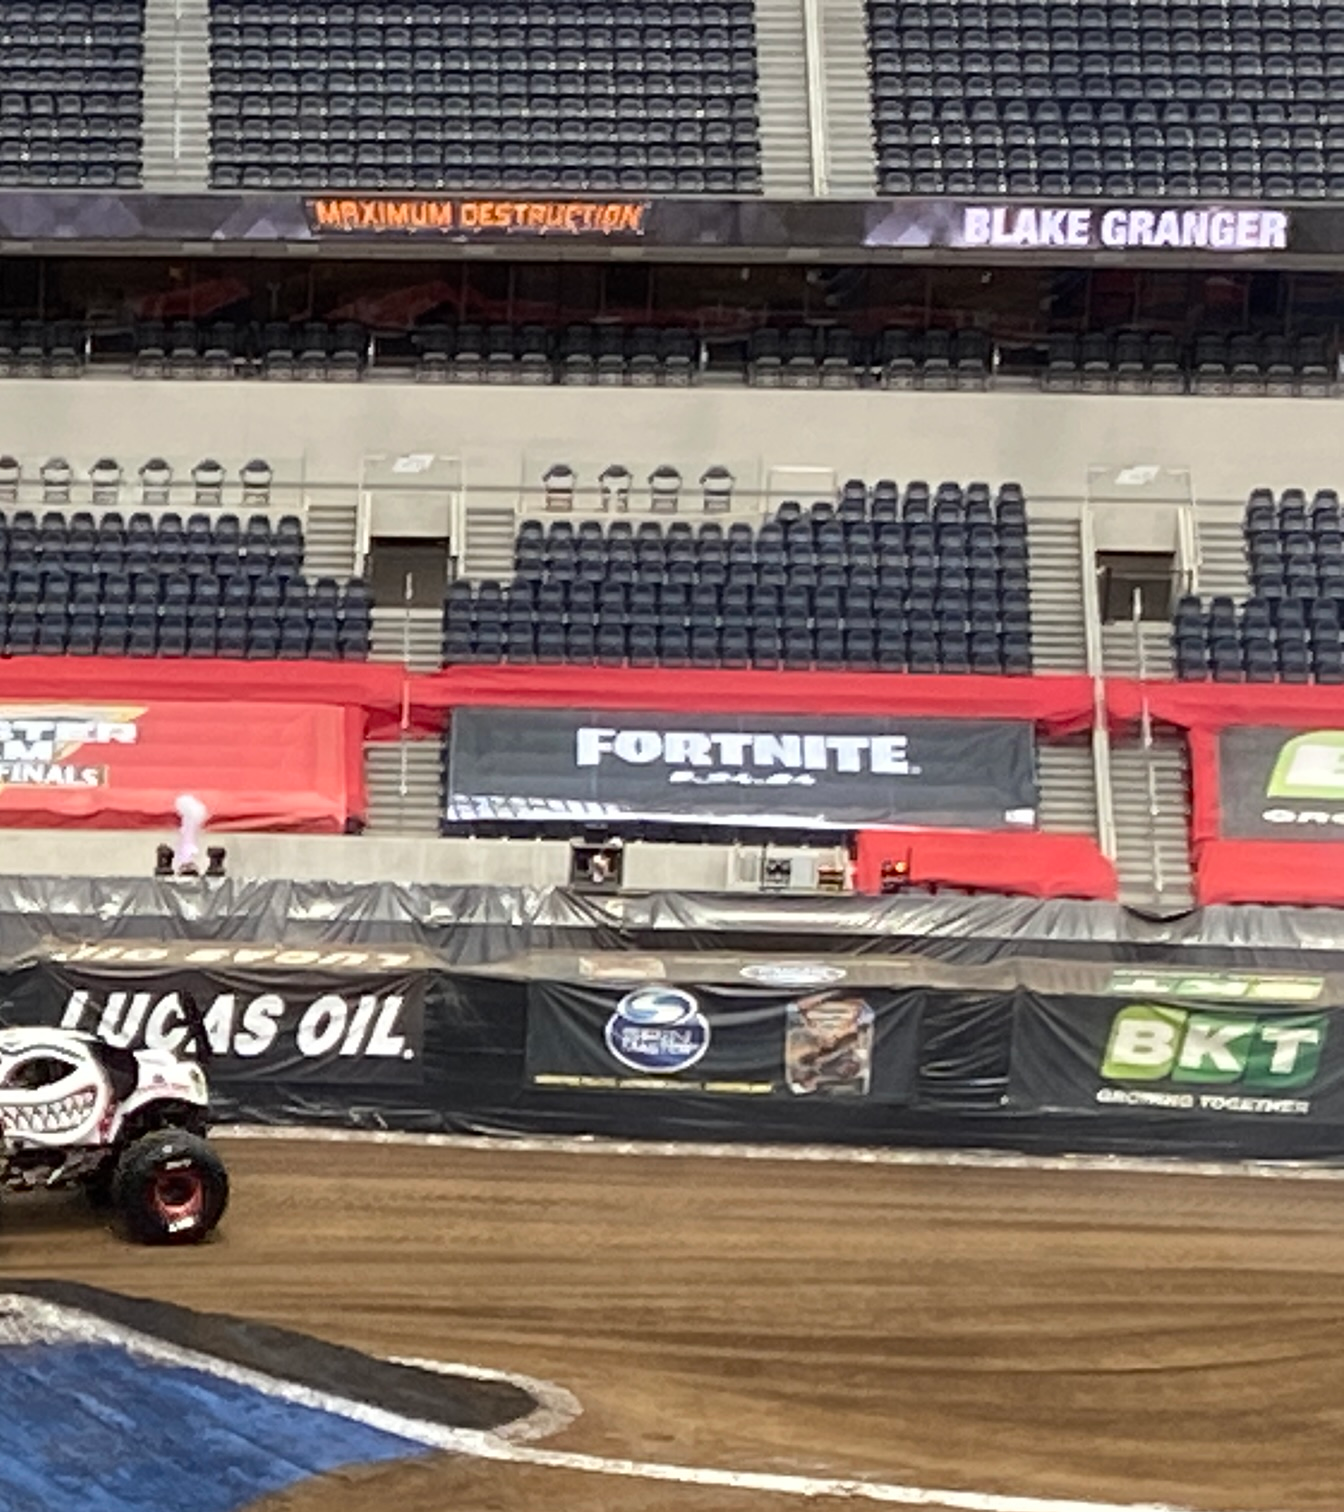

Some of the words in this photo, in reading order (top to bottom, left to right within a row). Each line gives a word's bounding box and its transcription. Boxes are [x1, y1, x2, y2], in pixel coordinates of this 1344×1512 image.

[315, 200, 453, 227] MAXIMUM
[462, 201, 645, 229] DESTRUCTION
[964, 207, 1092, 246] BLAKE
[1100, 208, 1288, 249] GRANGER
[576, 727, 910, 775] FORTNITE
[61, 988, 286, 1057] LUCAS
[1112, 1017, 1321, 1075] BKT
[1095, 1087, 1195, 1109] GROWING
[1199, 1093, 1311, 1115] TOGETHER
